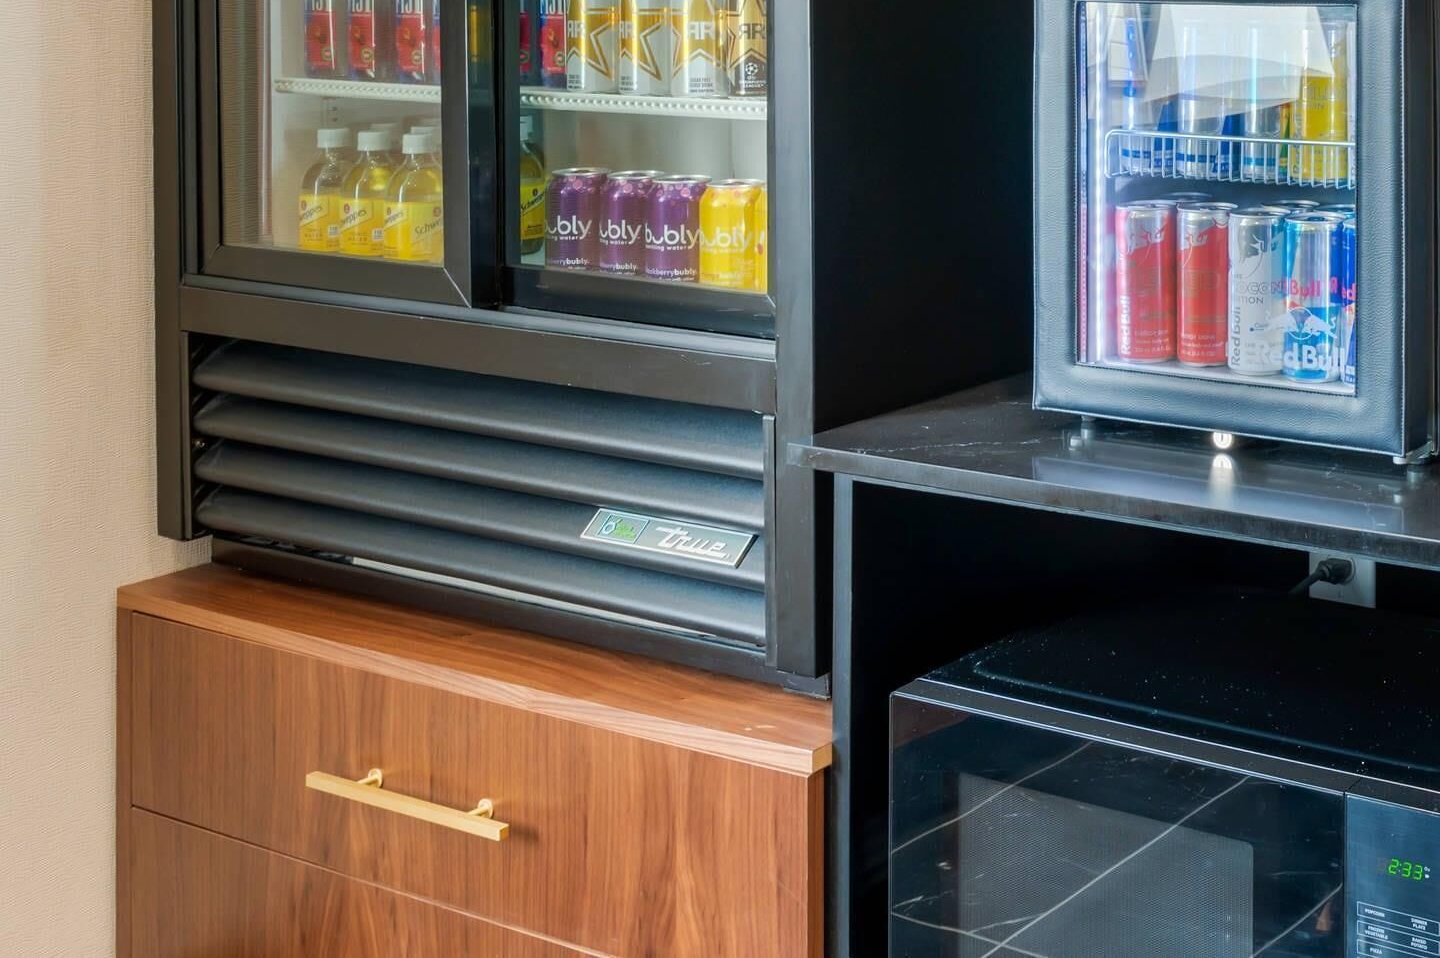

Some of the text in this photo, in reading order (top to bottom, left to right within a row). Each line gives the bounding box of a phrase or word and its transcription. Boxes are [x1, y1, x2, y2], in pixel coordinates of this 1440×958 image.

[1120, 295, 1131, 355] Red Bull
[1231, 306, 1241, 366] Red Bull
[1388, 858, 1423, 881] 2:33
